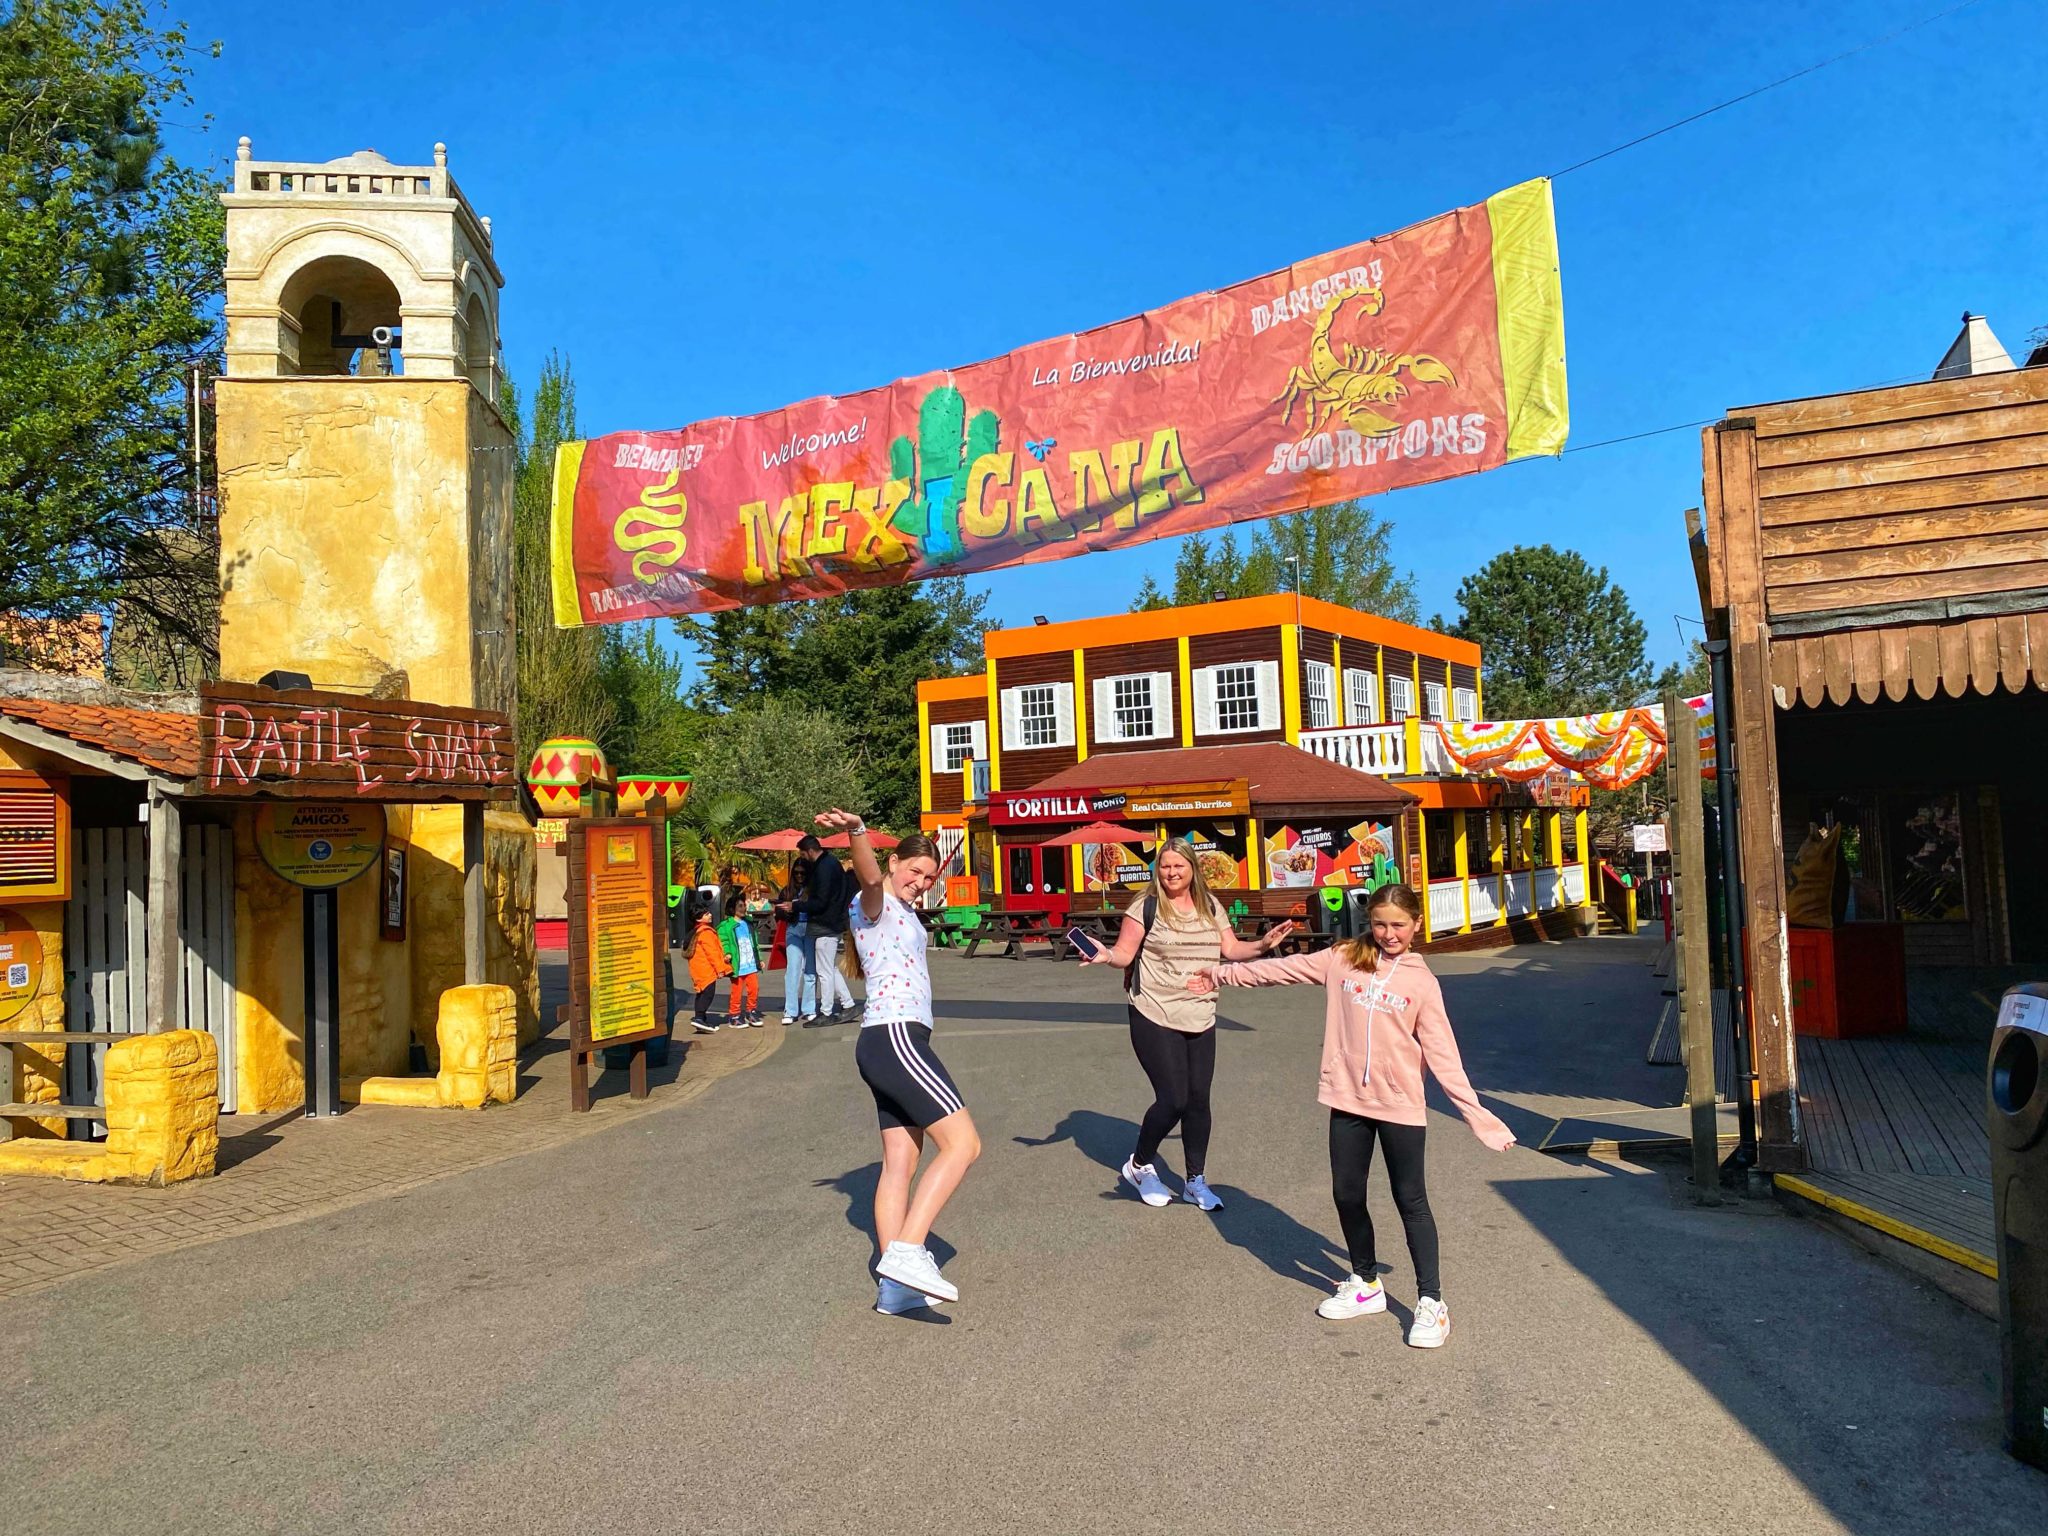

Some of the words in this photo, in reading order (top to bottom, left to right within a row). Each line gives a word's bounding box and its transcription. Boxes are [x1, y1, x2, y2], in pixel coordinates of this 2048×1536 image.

[1251, 258, 1384, 336] DANGER!
[1032, 366, 1060, 387] La
[1070, 340, 1201, 382] Bienvenida!
[762, 416, 867, 471] Welcome!
[1265, 413, 1487, 475] SCORPIONS
[739, 427, 1204, 587] MEXICANA
[405, 717, 510, 783] SNAKE
[291, 814, 350, 825] AMIGOS
[1007, 795, 1089, 818] TORTILLA
[1093, 796, 1126, 810] PRONTO
[1132, 803, 1151, 812] Real
[1151, 801, 1194, 811] California
[1194, 800, 1233, 809] Burritos
[1303, 832, 1332, 844] CHURROS
[1120, 872, 1151, 882] BURRITOS
